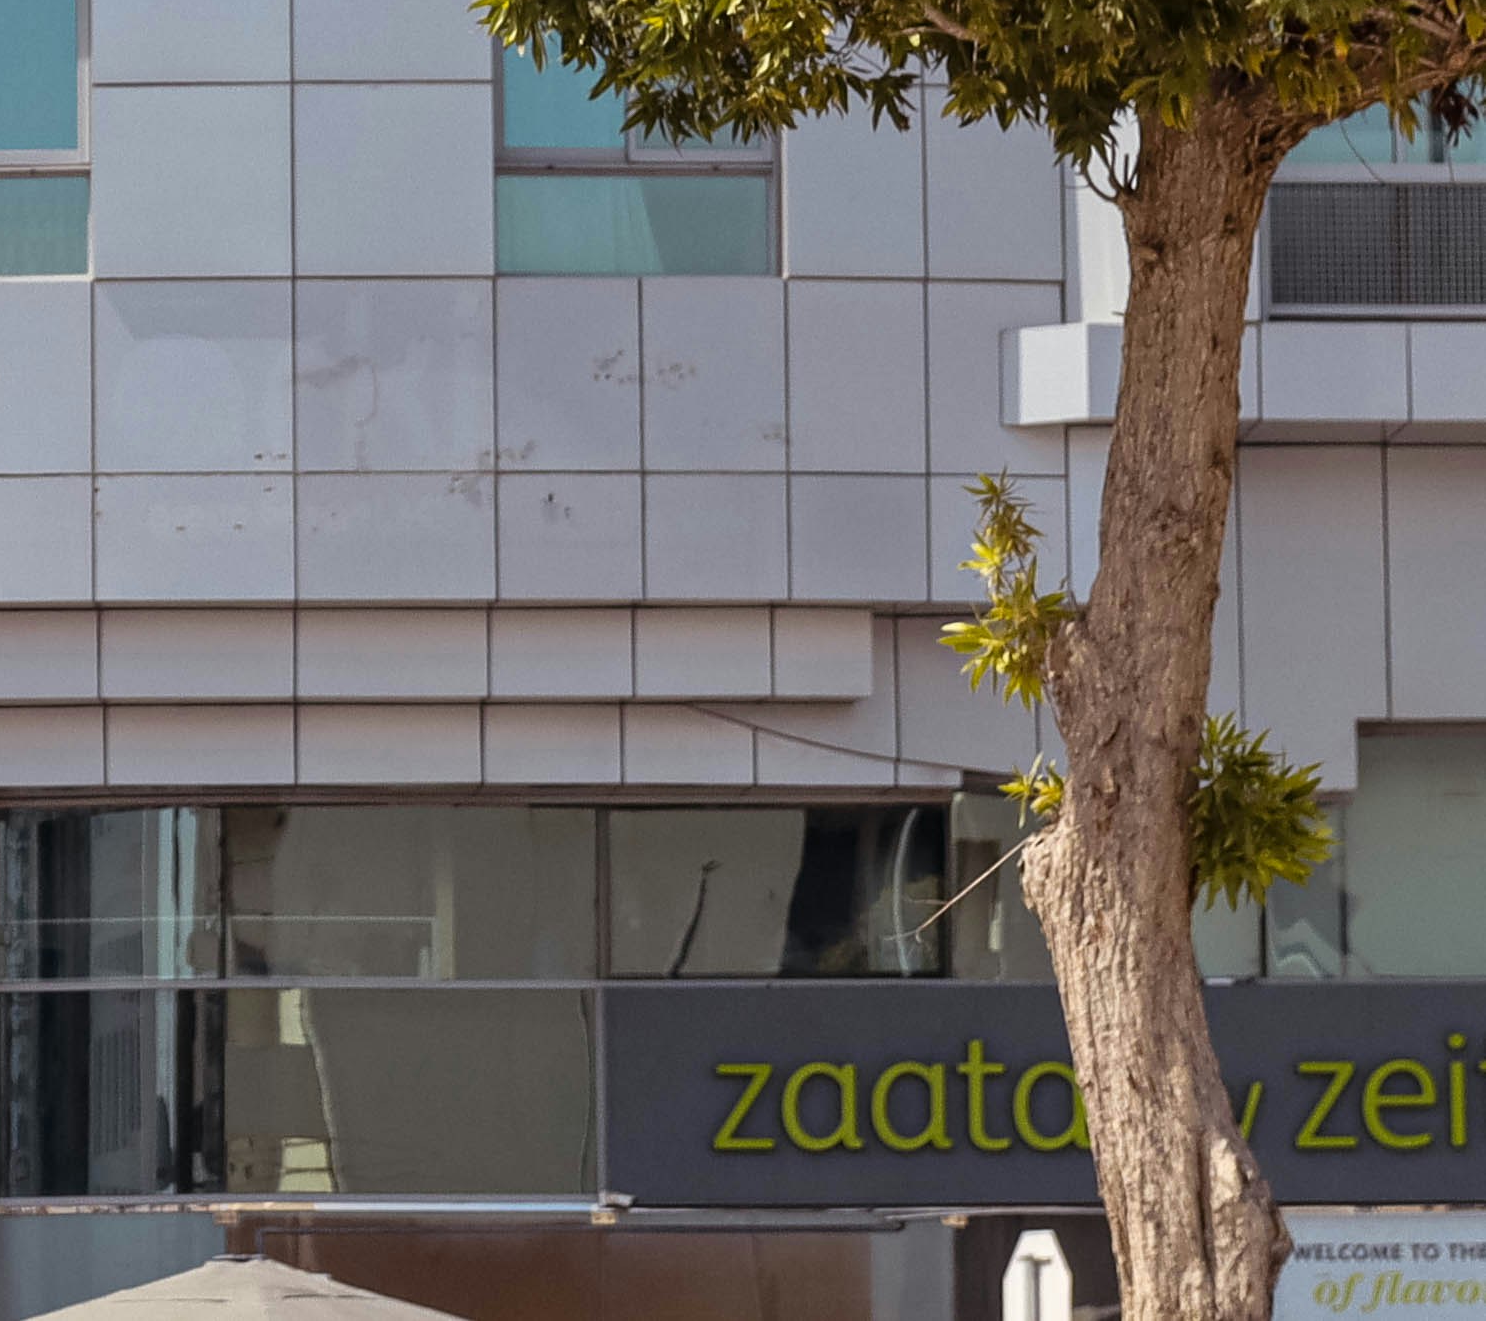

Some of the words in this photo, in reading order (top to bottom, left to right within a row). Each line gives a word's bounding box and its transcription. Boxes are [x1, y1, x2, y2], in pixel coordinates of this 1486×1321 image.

[712, 1039, 1094, 1151] zaata
[1295, 1033, 1486, 1150] zei
[1294, 1242, 1401, 1261] WELCOME
[1410, 1242, 1439, 1261] TO
[1361, 1269, 1486, 1314] flavo
